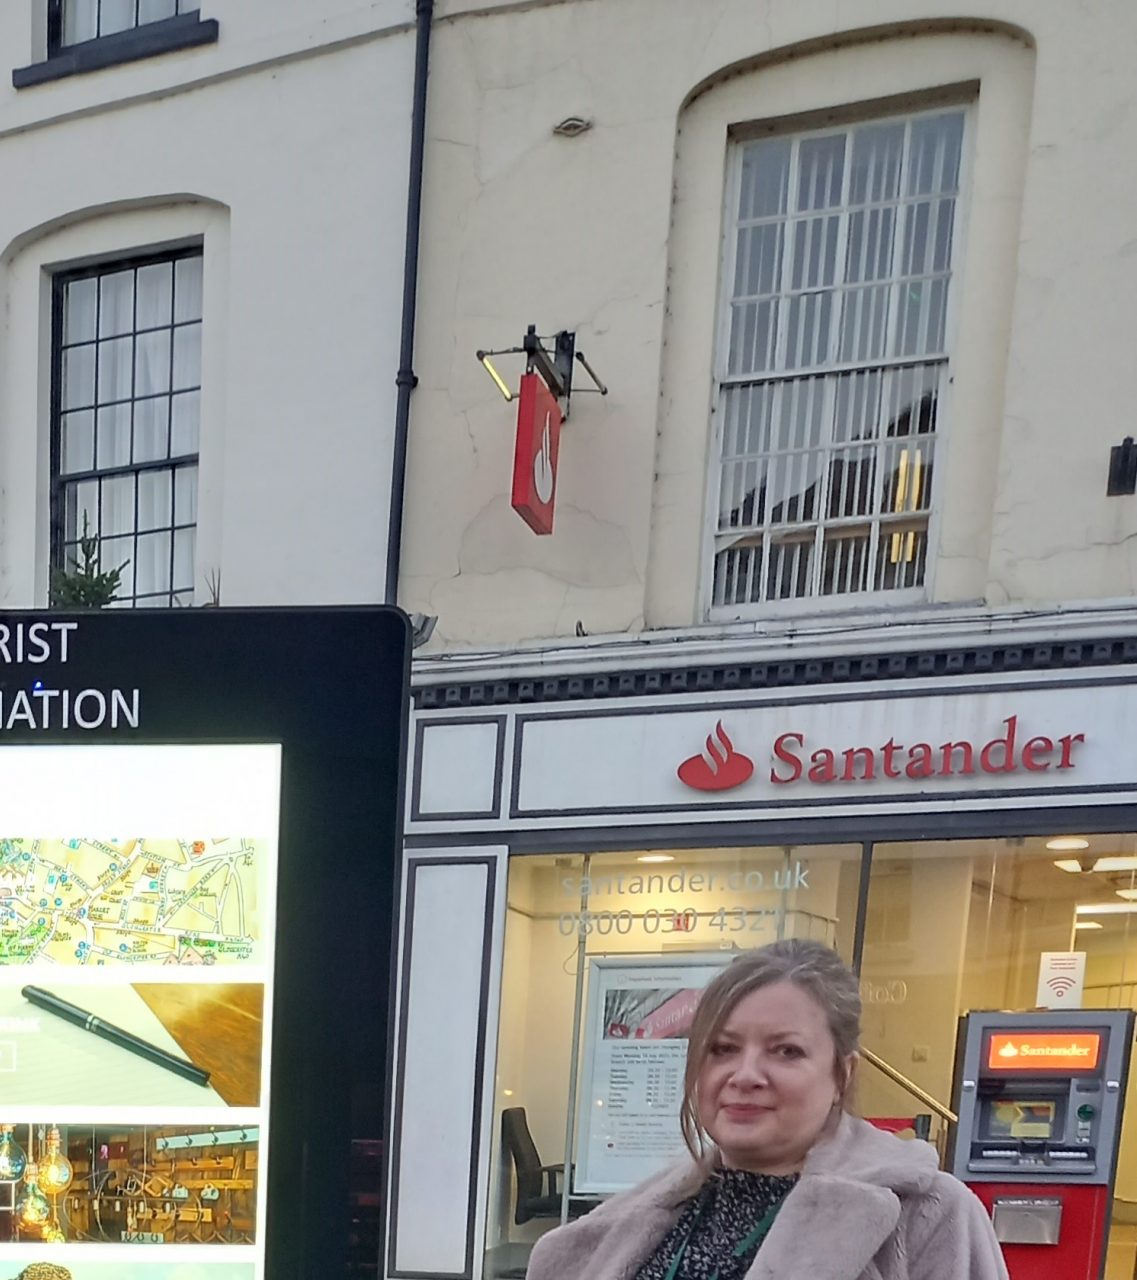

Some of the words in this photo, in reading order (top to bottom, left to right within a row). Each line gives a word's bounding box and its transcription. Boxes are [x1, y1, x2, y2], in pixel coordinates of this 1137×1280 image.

[770, 715, 1085, 785] Santander
[562, 861, 810, 896] santander.co.uk
[558, 909, 633, 936] 0800
[643, 908, 698, 934] 030
[1020, 1043, 1092, 1057] Santander
